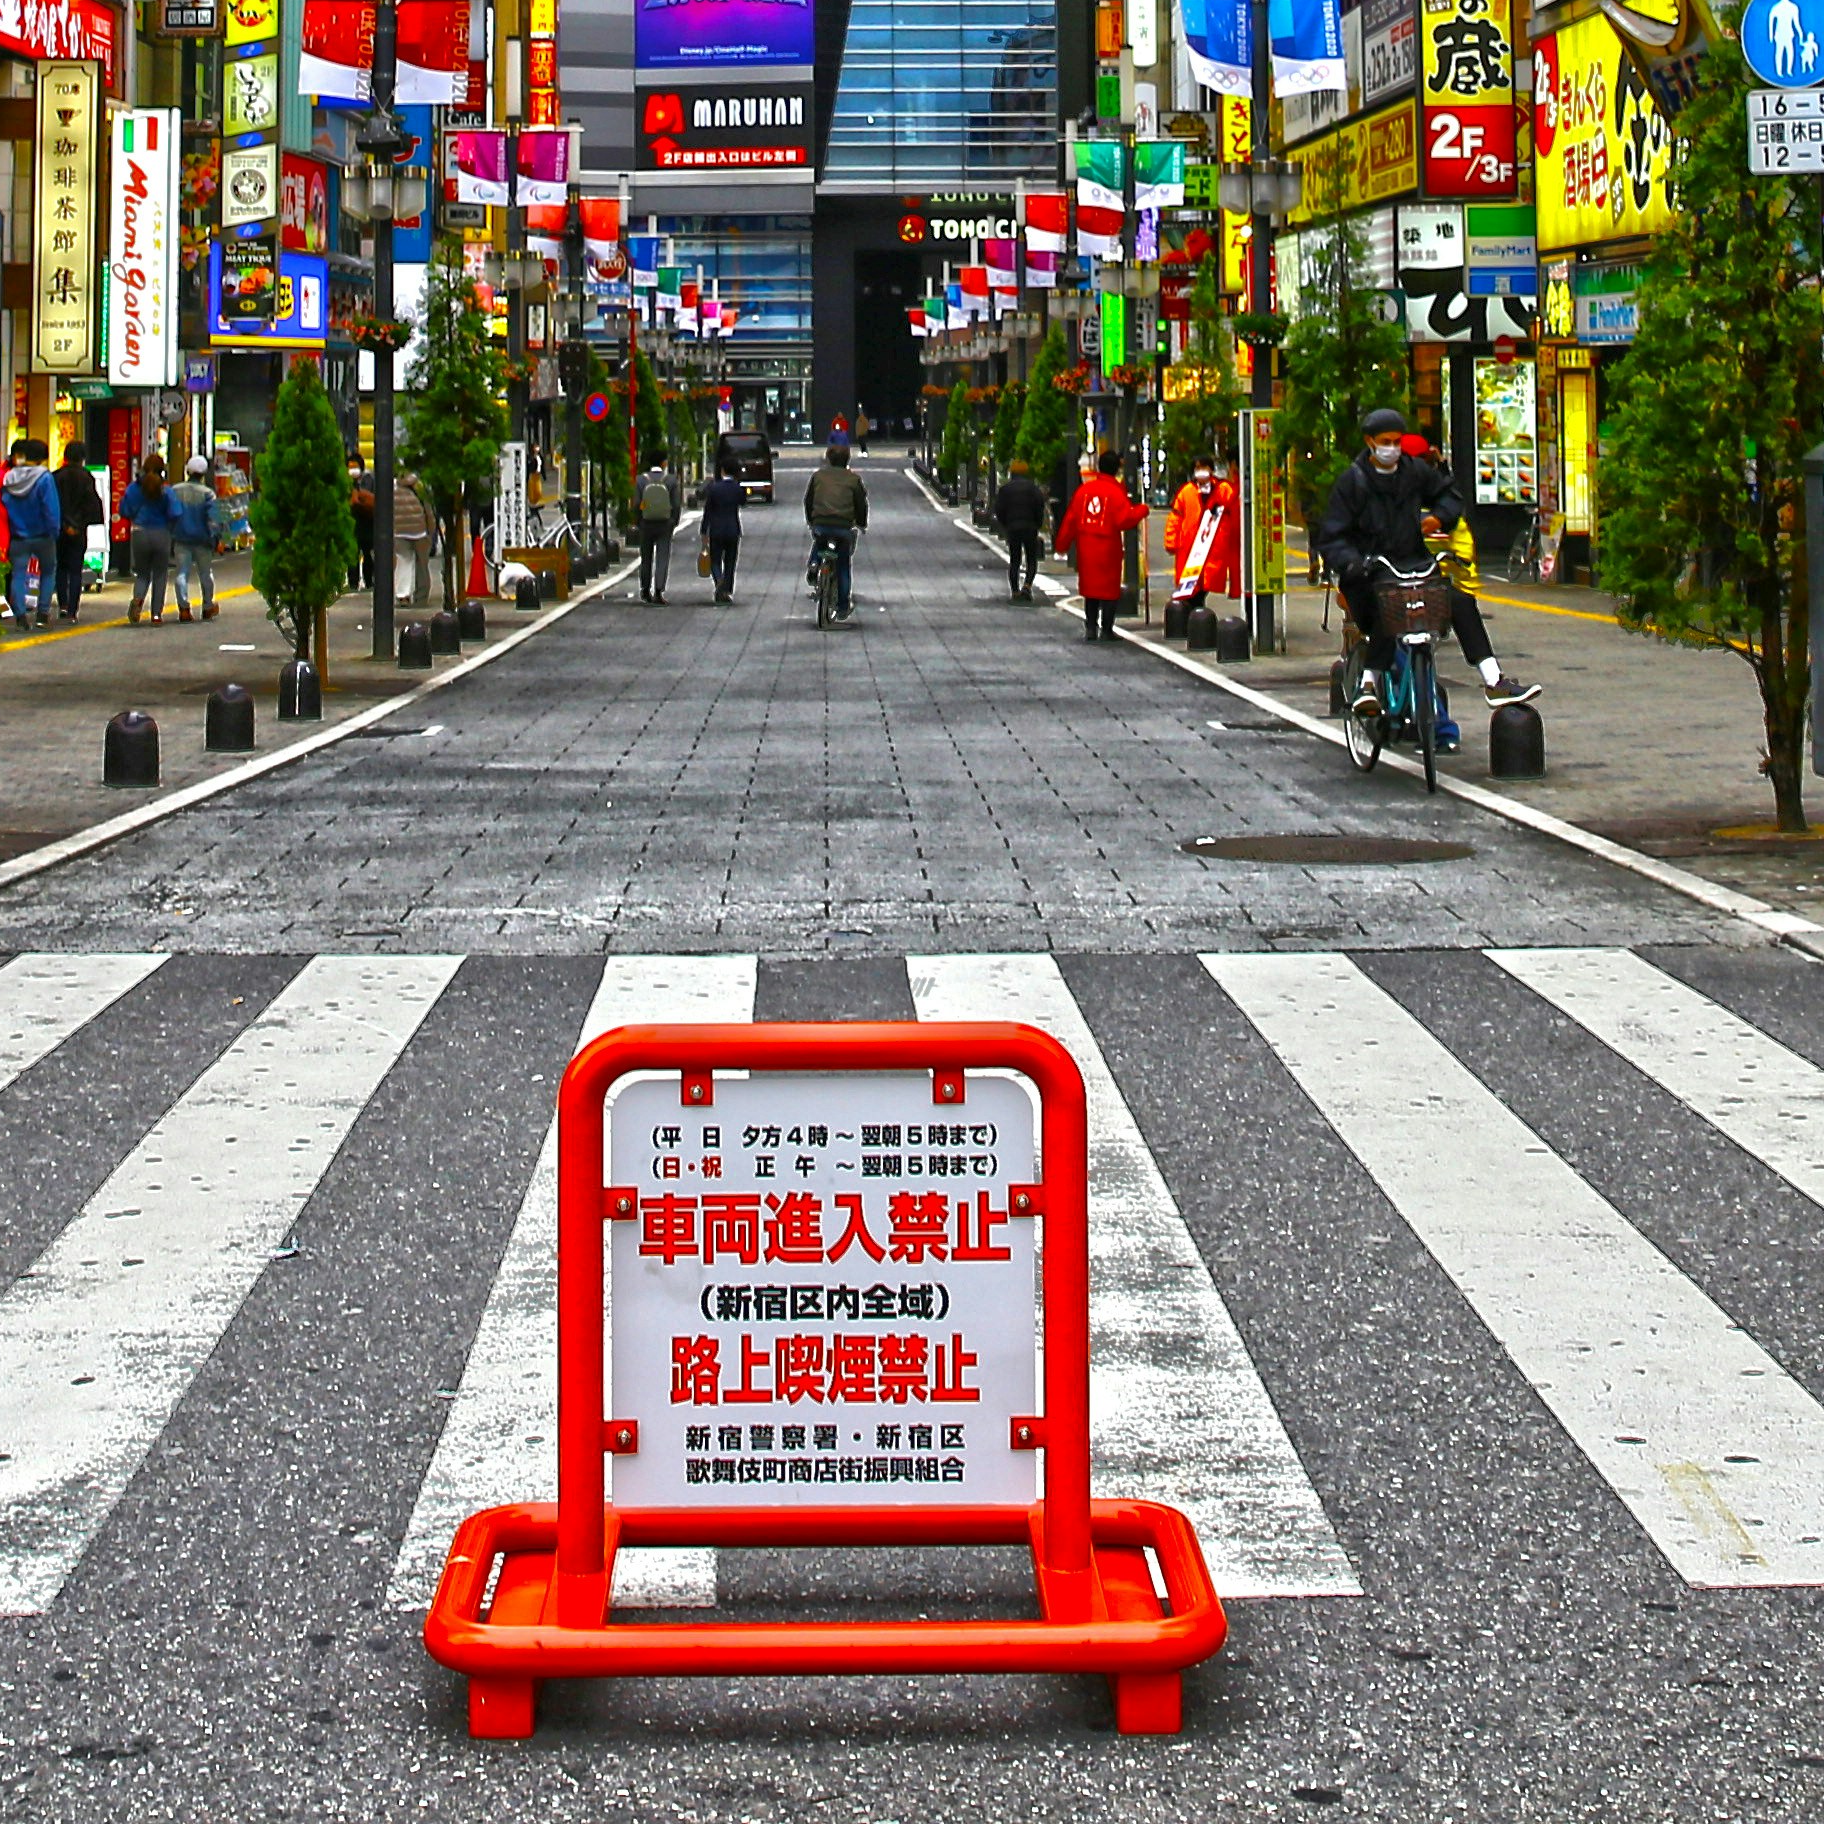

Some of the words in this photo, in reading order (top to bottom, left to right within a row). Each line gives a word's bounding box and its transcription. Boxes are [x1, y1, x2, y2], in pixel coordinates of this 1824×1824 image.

[694, 97, 804, 128] MARUHAN
[1430, 113, 1485, 159] 2F
[52, 137, 79, 255] 珈琲茶館
[122, 157, 149, 264] Miami
[931, 218, 989, 240] TOHO
[1403, 221, 1455, 247] 築地
[1471, 243, 1533, 260] FamilyMart
[45, 265, 83, 307] 集
[53, 339, 73, 353] 2F
[638, 1190, 1013, 1266] 車両進入禁止
[699, 1283, 952, 1321] (新宿区内全域)
[670, 1332, 982, 1407] 路上喫煙禁止
[685, 1457, 967, 1485] 歌舞伎町商店街振興組合
